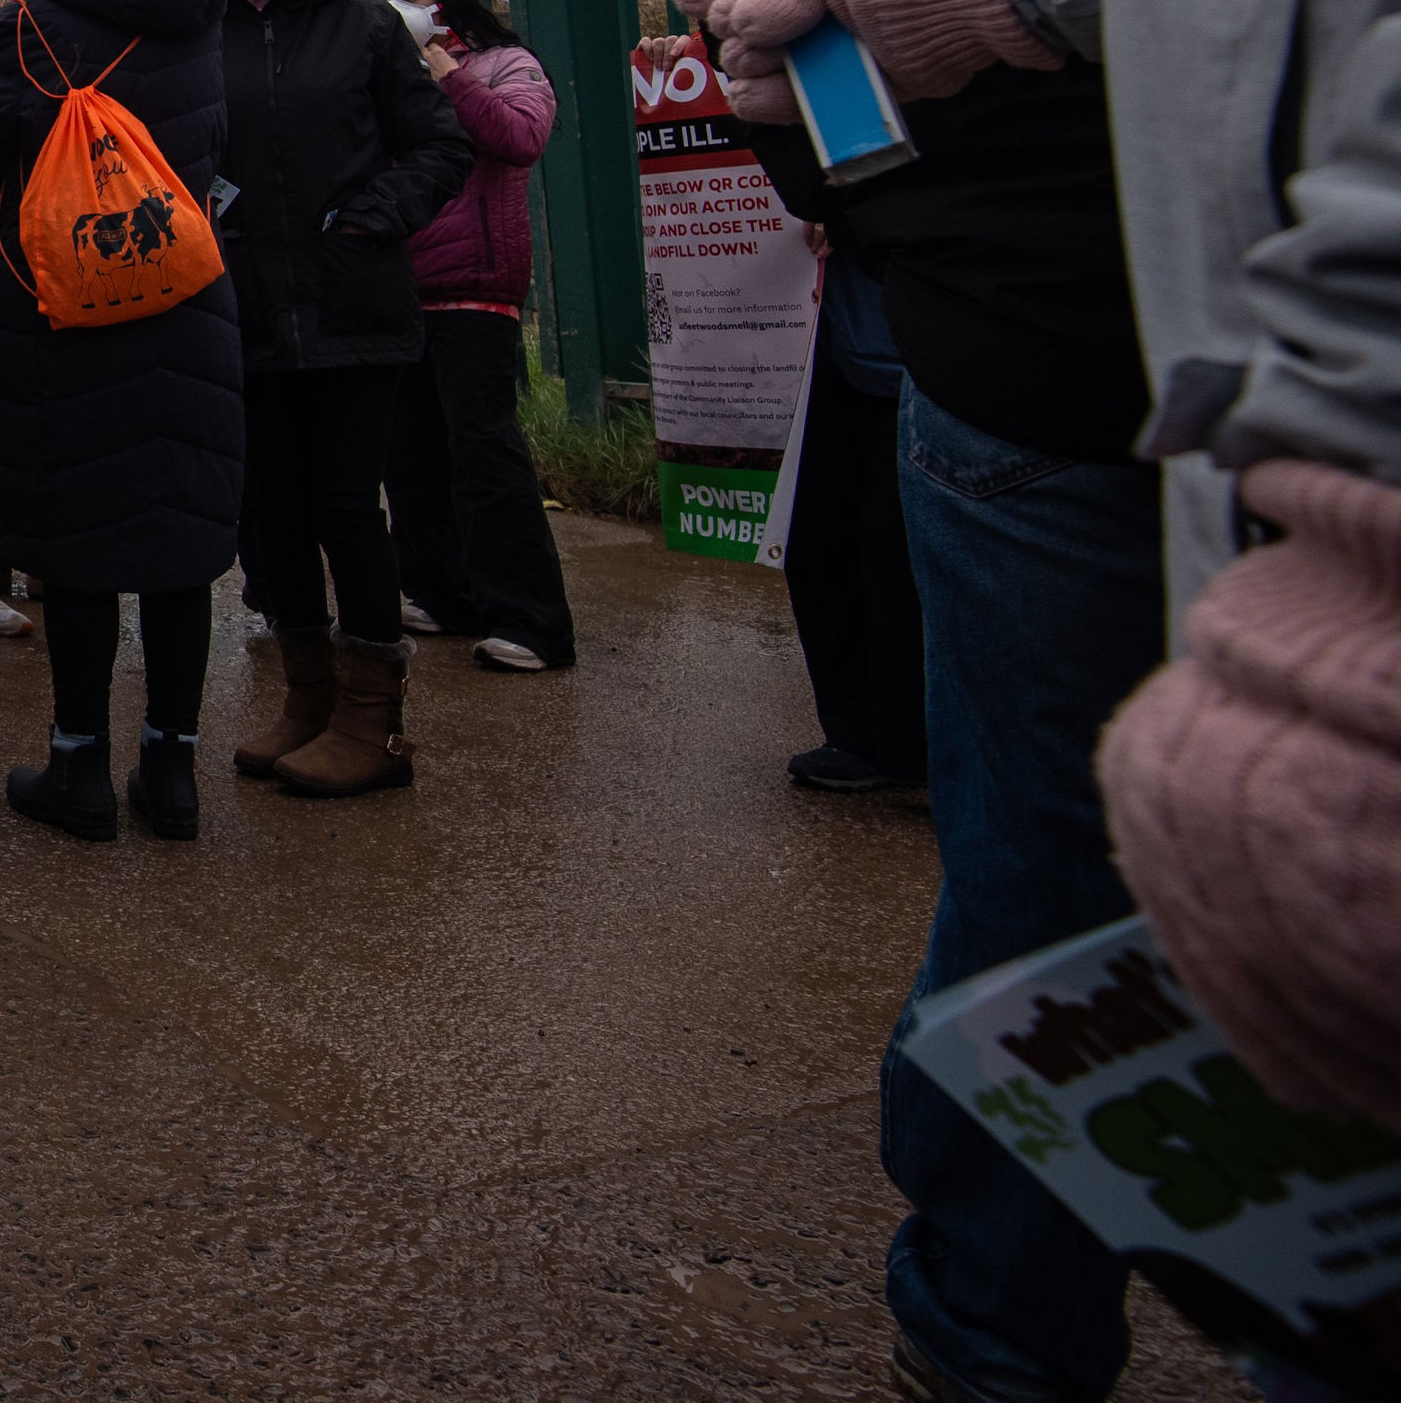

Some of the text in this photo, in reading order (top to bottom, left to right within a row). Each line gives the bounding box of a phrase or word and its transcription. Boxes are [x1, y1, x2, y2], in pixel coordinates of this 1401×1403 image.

[635, 123, 730, 153] PLE ILL.
[655, 179, 704, 196] BELOW
[708, 177, 733, 193] QR
[670, 201, 698, 215] OUR
[701, 196, 770, 213] ACTION
[659, 224, 687, 237] AND
[690, 219, 743, 235] CLOSE
[746, 217, 784, 232] THE
[698, 241, 759, 257] DOWN!
[671, 289, 683, 297] Not
[695, 287, 741, 298] Facebook?
[674, 305, 692, 314] Email
[704, 305, 716, 314] for
[717, 305, 742, 314] more
[743, 302, 803, 314] information
[684, 364, 717, 373] committed
[727, 364, 756, 374] closing
[757, 365, 771, 373] the
[773, 364, 798, 373] landfill
[696, 380, 717, 388] public
[718, 380, 756, 389] meetings.
[689, 395, 726, 405] Community
[727, 396, 756, 404] Liaison
[699, 410, 716, 418] local
[717, 411, 758, 420] councillors
[759, 412, 774, 420] and
[680, 483, 766, 515] POWER
